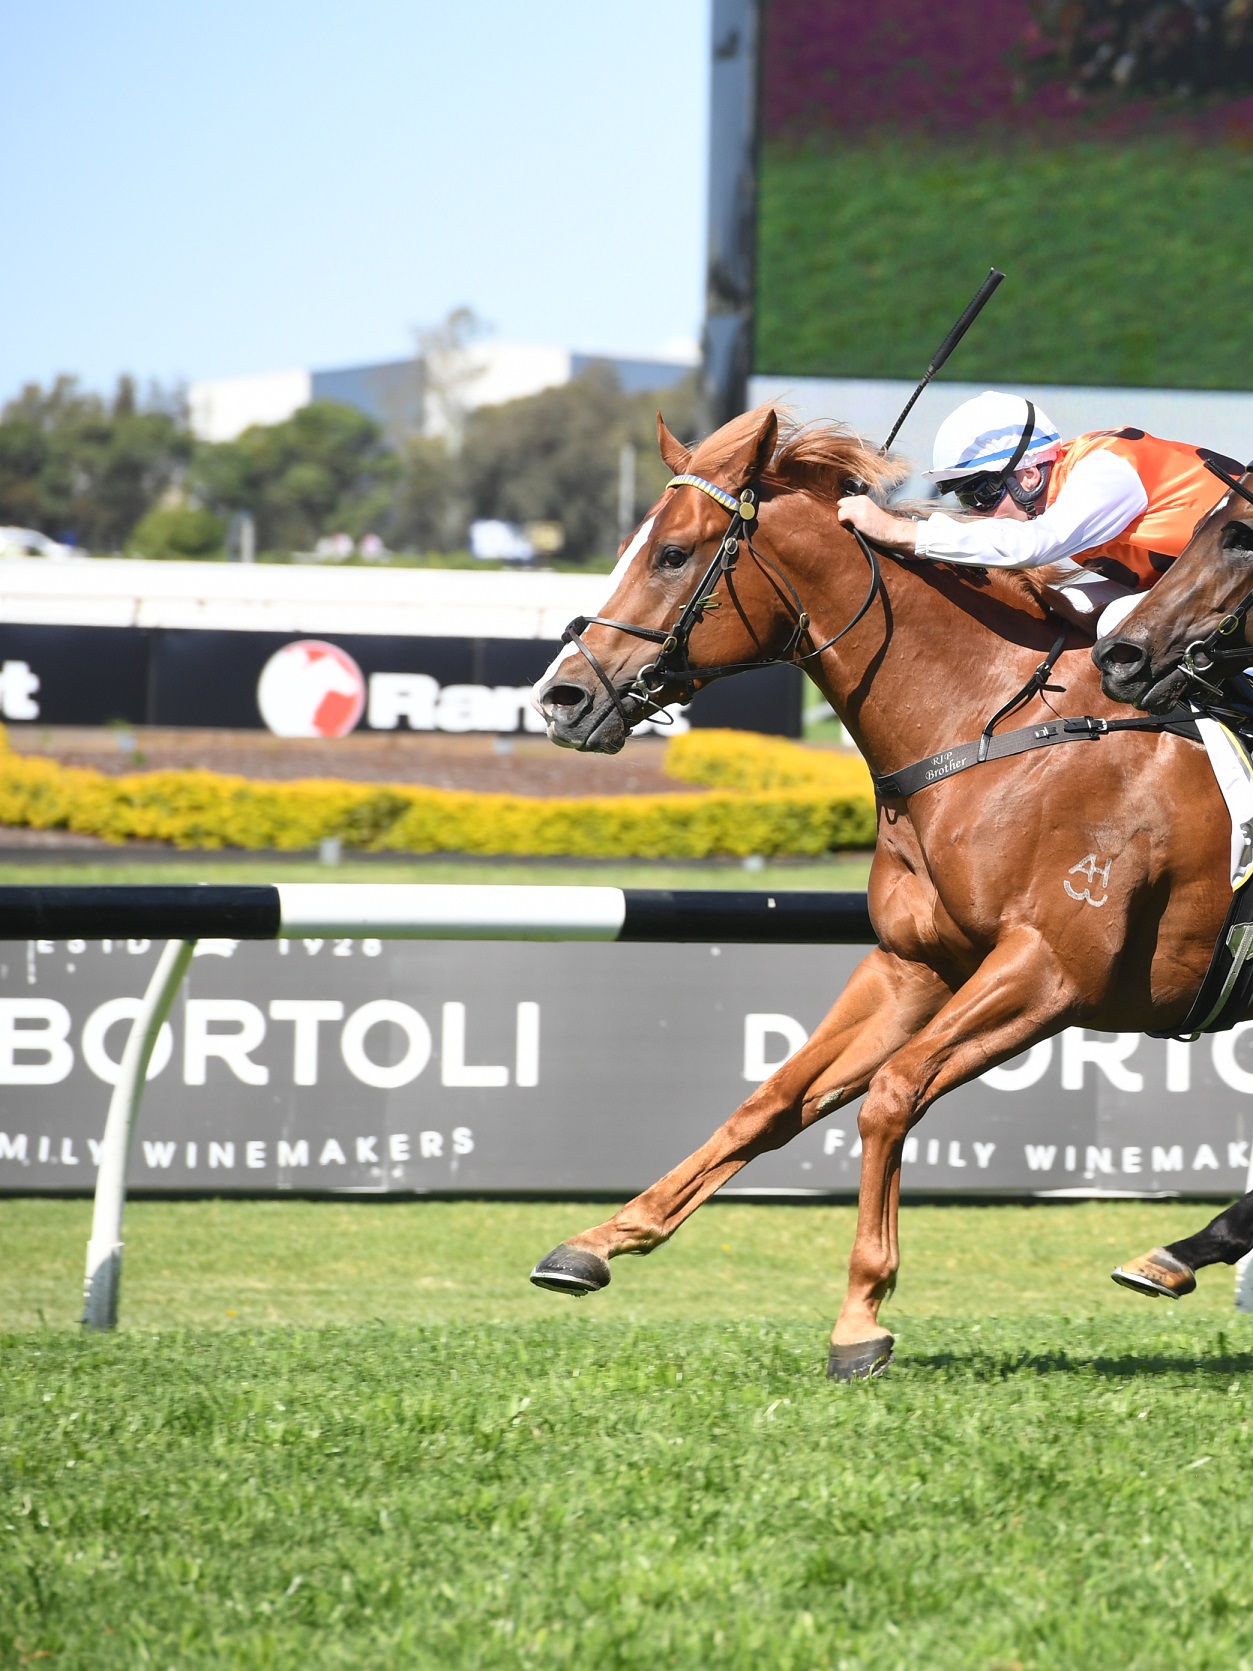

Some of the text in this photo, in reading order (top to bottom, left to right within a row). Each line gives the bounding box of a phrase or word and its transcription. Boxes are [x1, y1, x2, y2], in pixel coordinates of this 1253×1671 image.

[925, 757, 967, 780] Brother
[0, 997, 540, 1088] BORTOLI
[143, 1127, 474, 1169] WINEMAKERS
